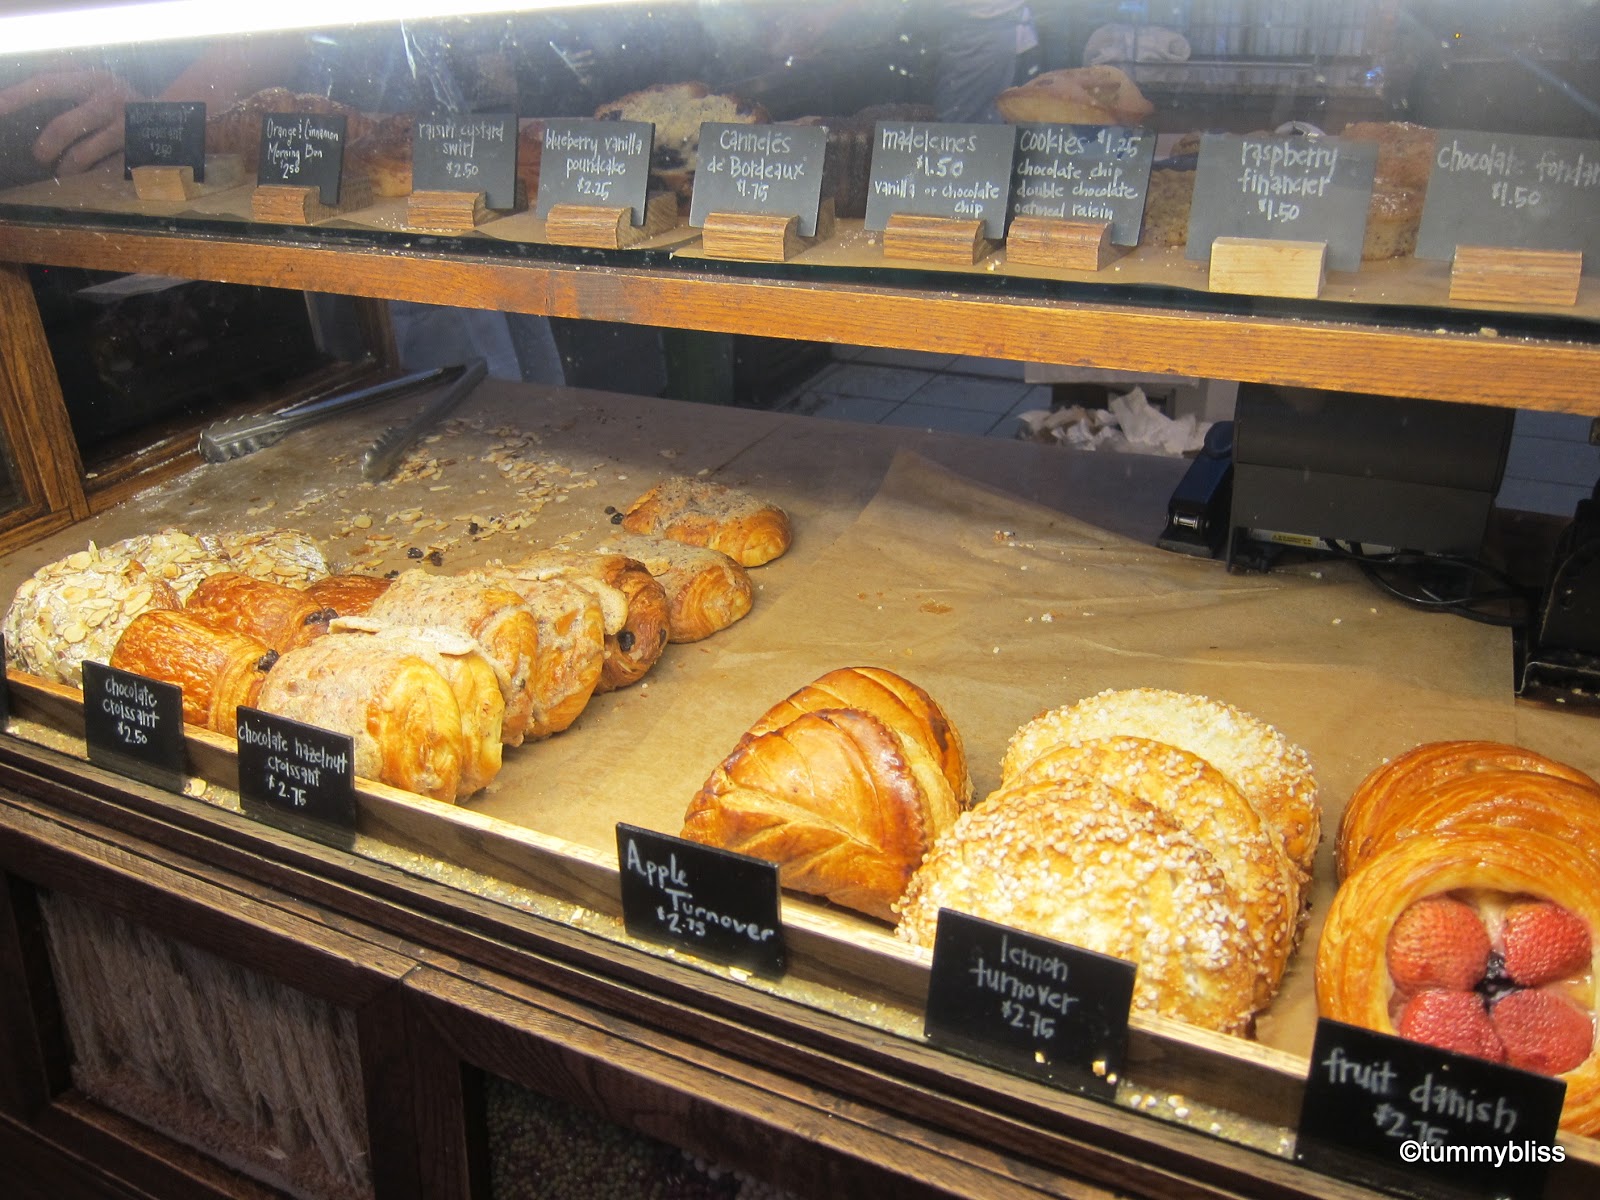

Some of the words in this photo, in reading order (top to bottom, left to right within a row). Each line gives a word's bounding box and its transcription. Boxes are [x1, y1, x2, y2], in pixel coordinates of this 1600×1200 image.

[266, 117, 297, 147] Orange
[304, 118, 339, 142] Cinnamon
[418, 117, 455, 139] raisin
[460, 122, 504, 142] custard
[882, 127, 978, 153] madeleines
[267, 142, 300, 166] Morning
[442, 138, 475, 158] swirl
[545, 128, 598, 160] blueberry
[604, 132, 643, 155] vanilla
[446, 162, 479, 179] $2.50
[566, 155, 626, 178] poundcake
[729, 155, 805, 181] Bordeaux
[916, 154, 964, 178] $1.50
[1241, 140, 1338, 179] raspberry
[1016, 162, 1082, 180] chocolate
[1090, 162, 1123, 187] chip
[1237, 166, 1330, 198] financier
[577, 177, 612, 200] $2.25
[736, 178, 770, 202] $1.75
[873, 179, 915, 198] vanilla
[924, 187, 937, 197] or
[942, 182, 1000, 200] chocolate
[1016, 181, 1064, 199] double
[1072, 182, 1138, 200] chocolate
[1491, 180, 1542, 209] $1.50
[953, 200, 984, 218] chip
[1014, 202, 1064, 218] oatmeal
[1072, 200, 1114, 220] raisin
[1258, 198, 1300, 223] $1.50
[104, 675, 158, 708] chocolate
[102, 698, 160, 729] croissant
[117, 721, 148, 745] $2.50
[238, 721, 289, 752] chocolate
[294, 737, 348, 774] hazelnut
[267, 755, 321, 787] croissant
[626, 838, 689, 890] Apple
[656, 905, 706, 937] $2.75
[664, 887, 775, 942] Turnover
[1000, 934, 1069, 983] lemon
[969, 957, 1079, 1015] turnover
[1001, 999, 1056, 1040] $2.75
[1321, 1046, 1398, 1095] fruit
[1408, 1072, 1518, 1134] danish
[1372, 1102, 1449, 1150] $2.75
